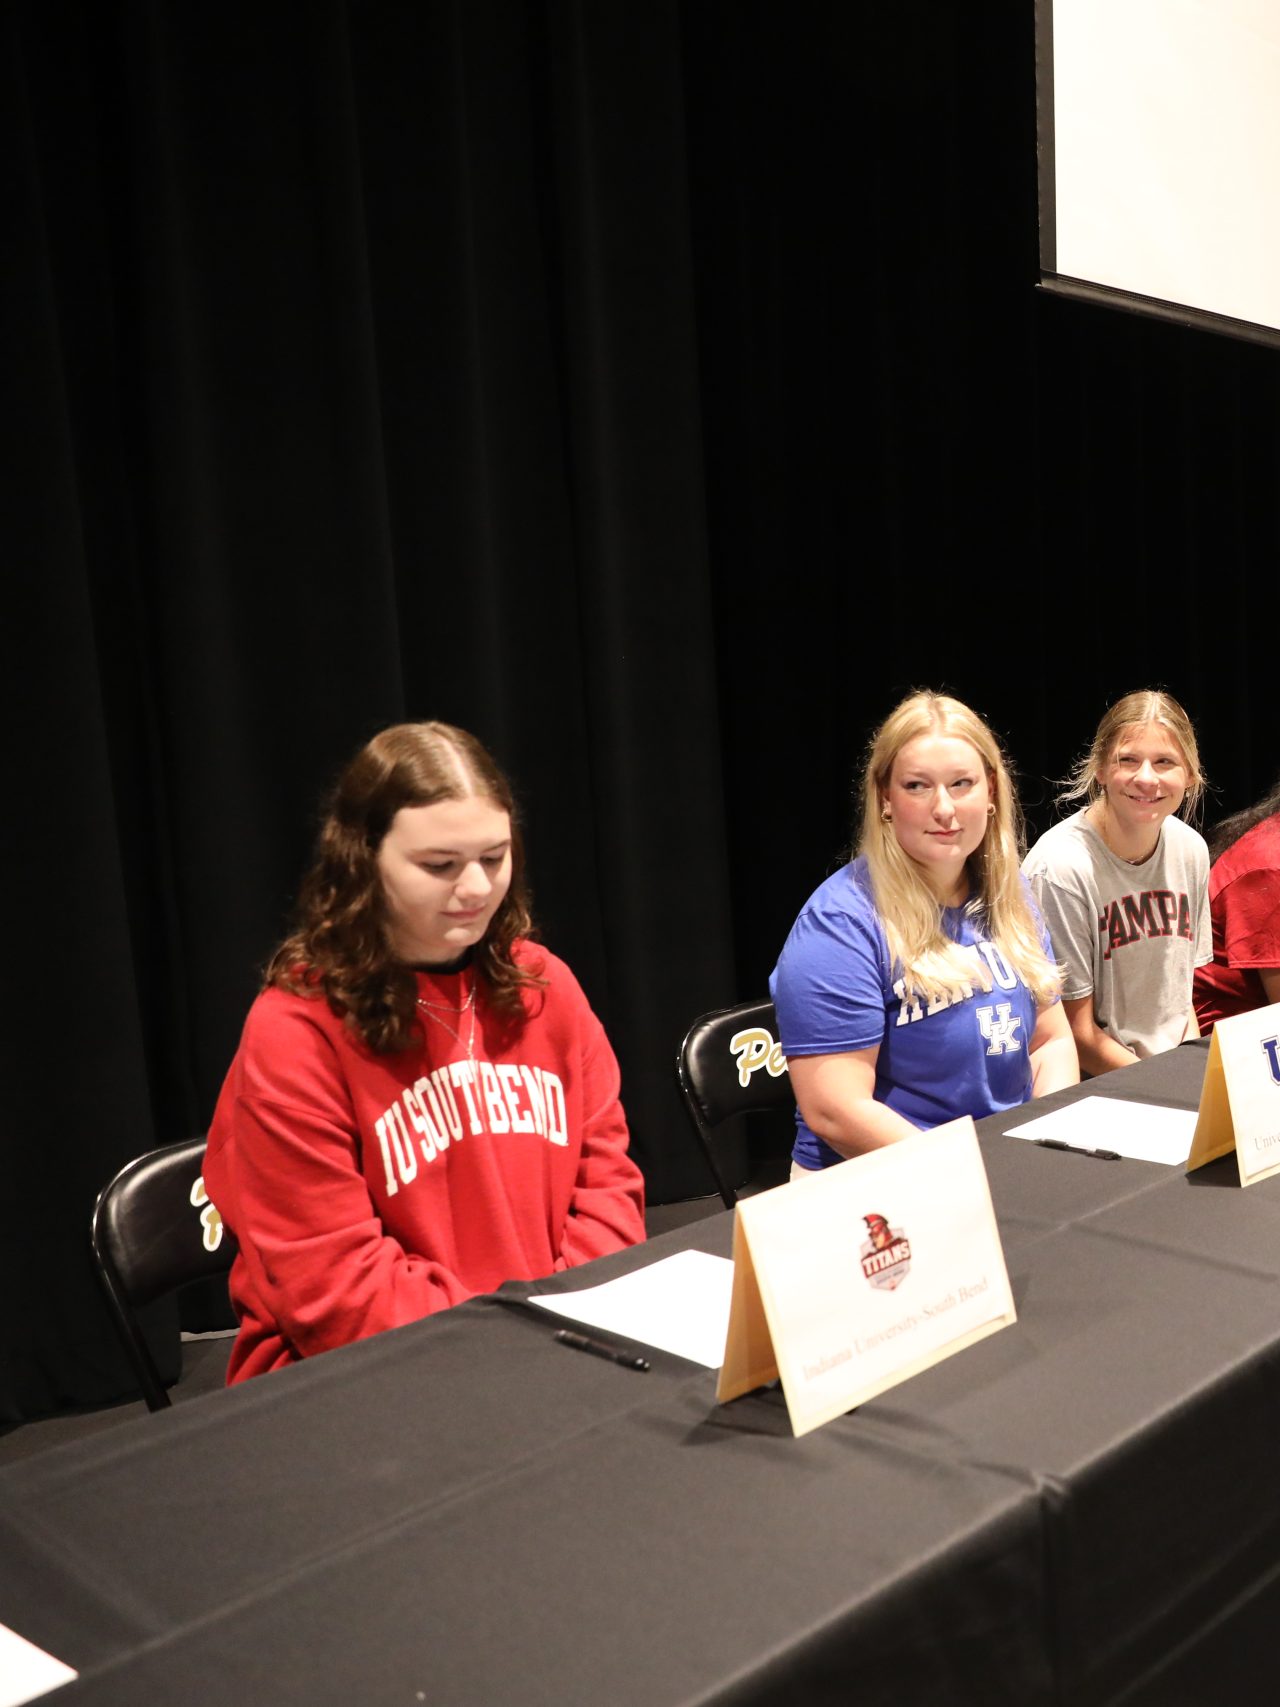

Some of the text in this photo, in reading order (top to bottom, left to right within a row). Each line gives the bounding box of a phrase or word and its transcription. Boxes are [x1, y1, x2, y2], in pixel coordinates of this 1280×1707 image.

[730, 1027, 788, 1088] Pe
[976, 1002, 1021, 1056] UK
[374, 1100, 418, 1197] IU
[480, 1061, 568, 1147] BEND
[862, 1241, 911, 1275] TITANS
[802, 1348, 853, 1381] Indiana
[958, 1276, 989, 1303] Bend
